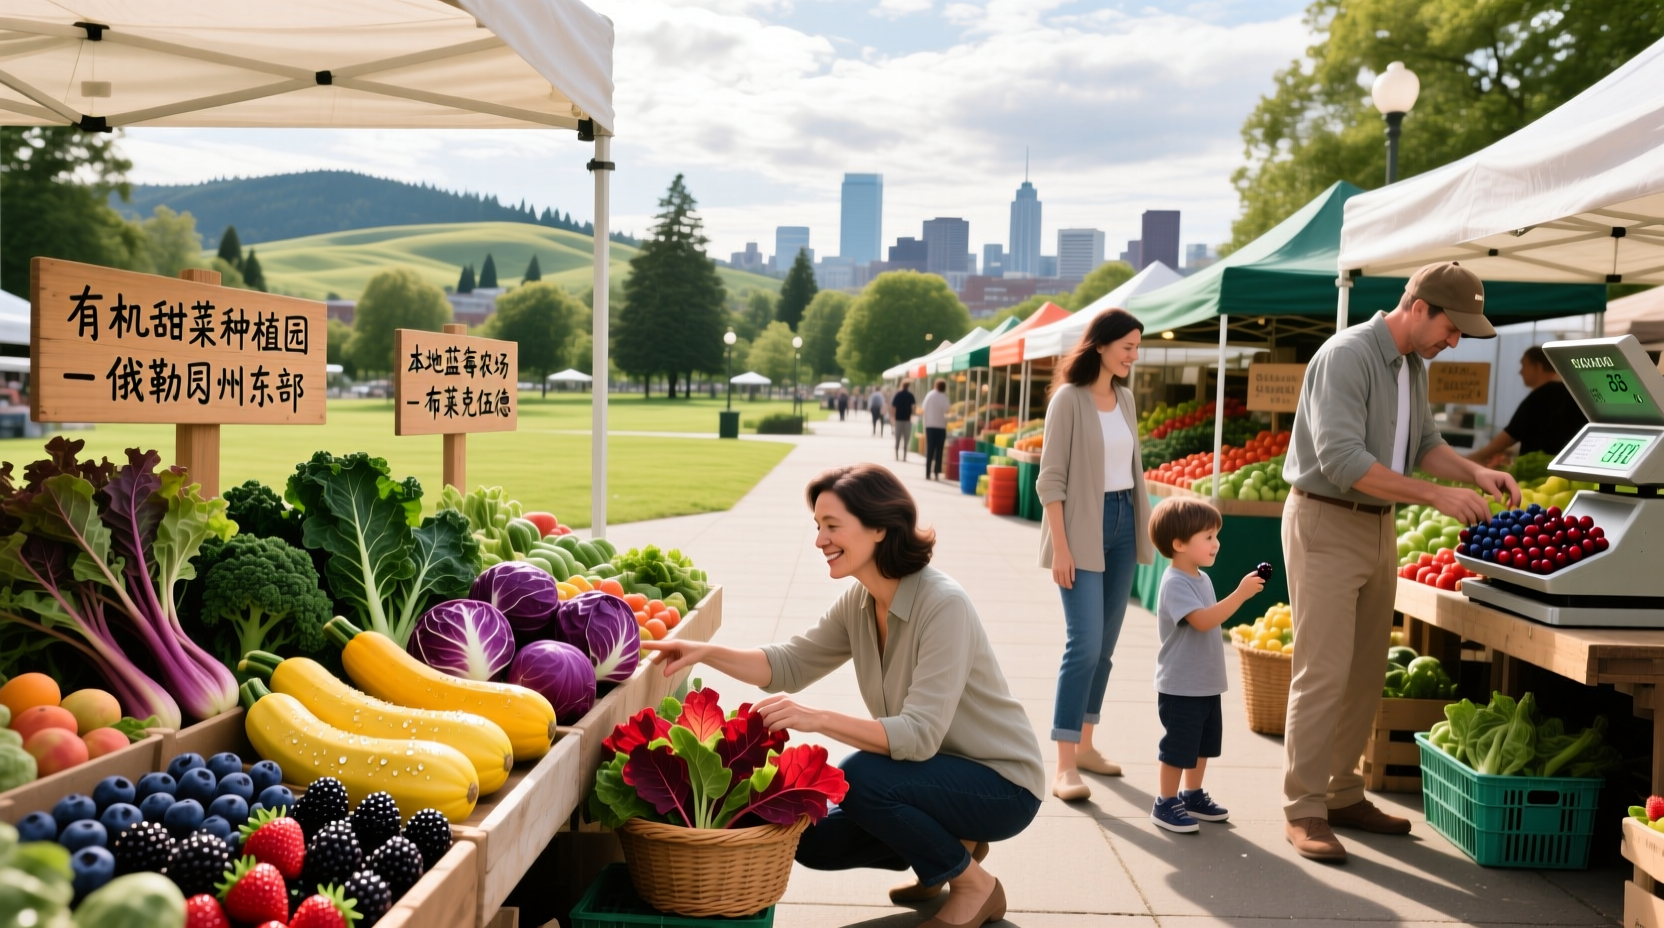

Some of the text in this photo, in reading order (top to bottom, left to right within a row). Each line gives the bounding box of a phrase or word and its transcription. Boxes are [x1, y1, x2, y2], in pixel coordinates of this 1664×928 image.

[67, 284, 309, 355] 有机甜菜种植园
